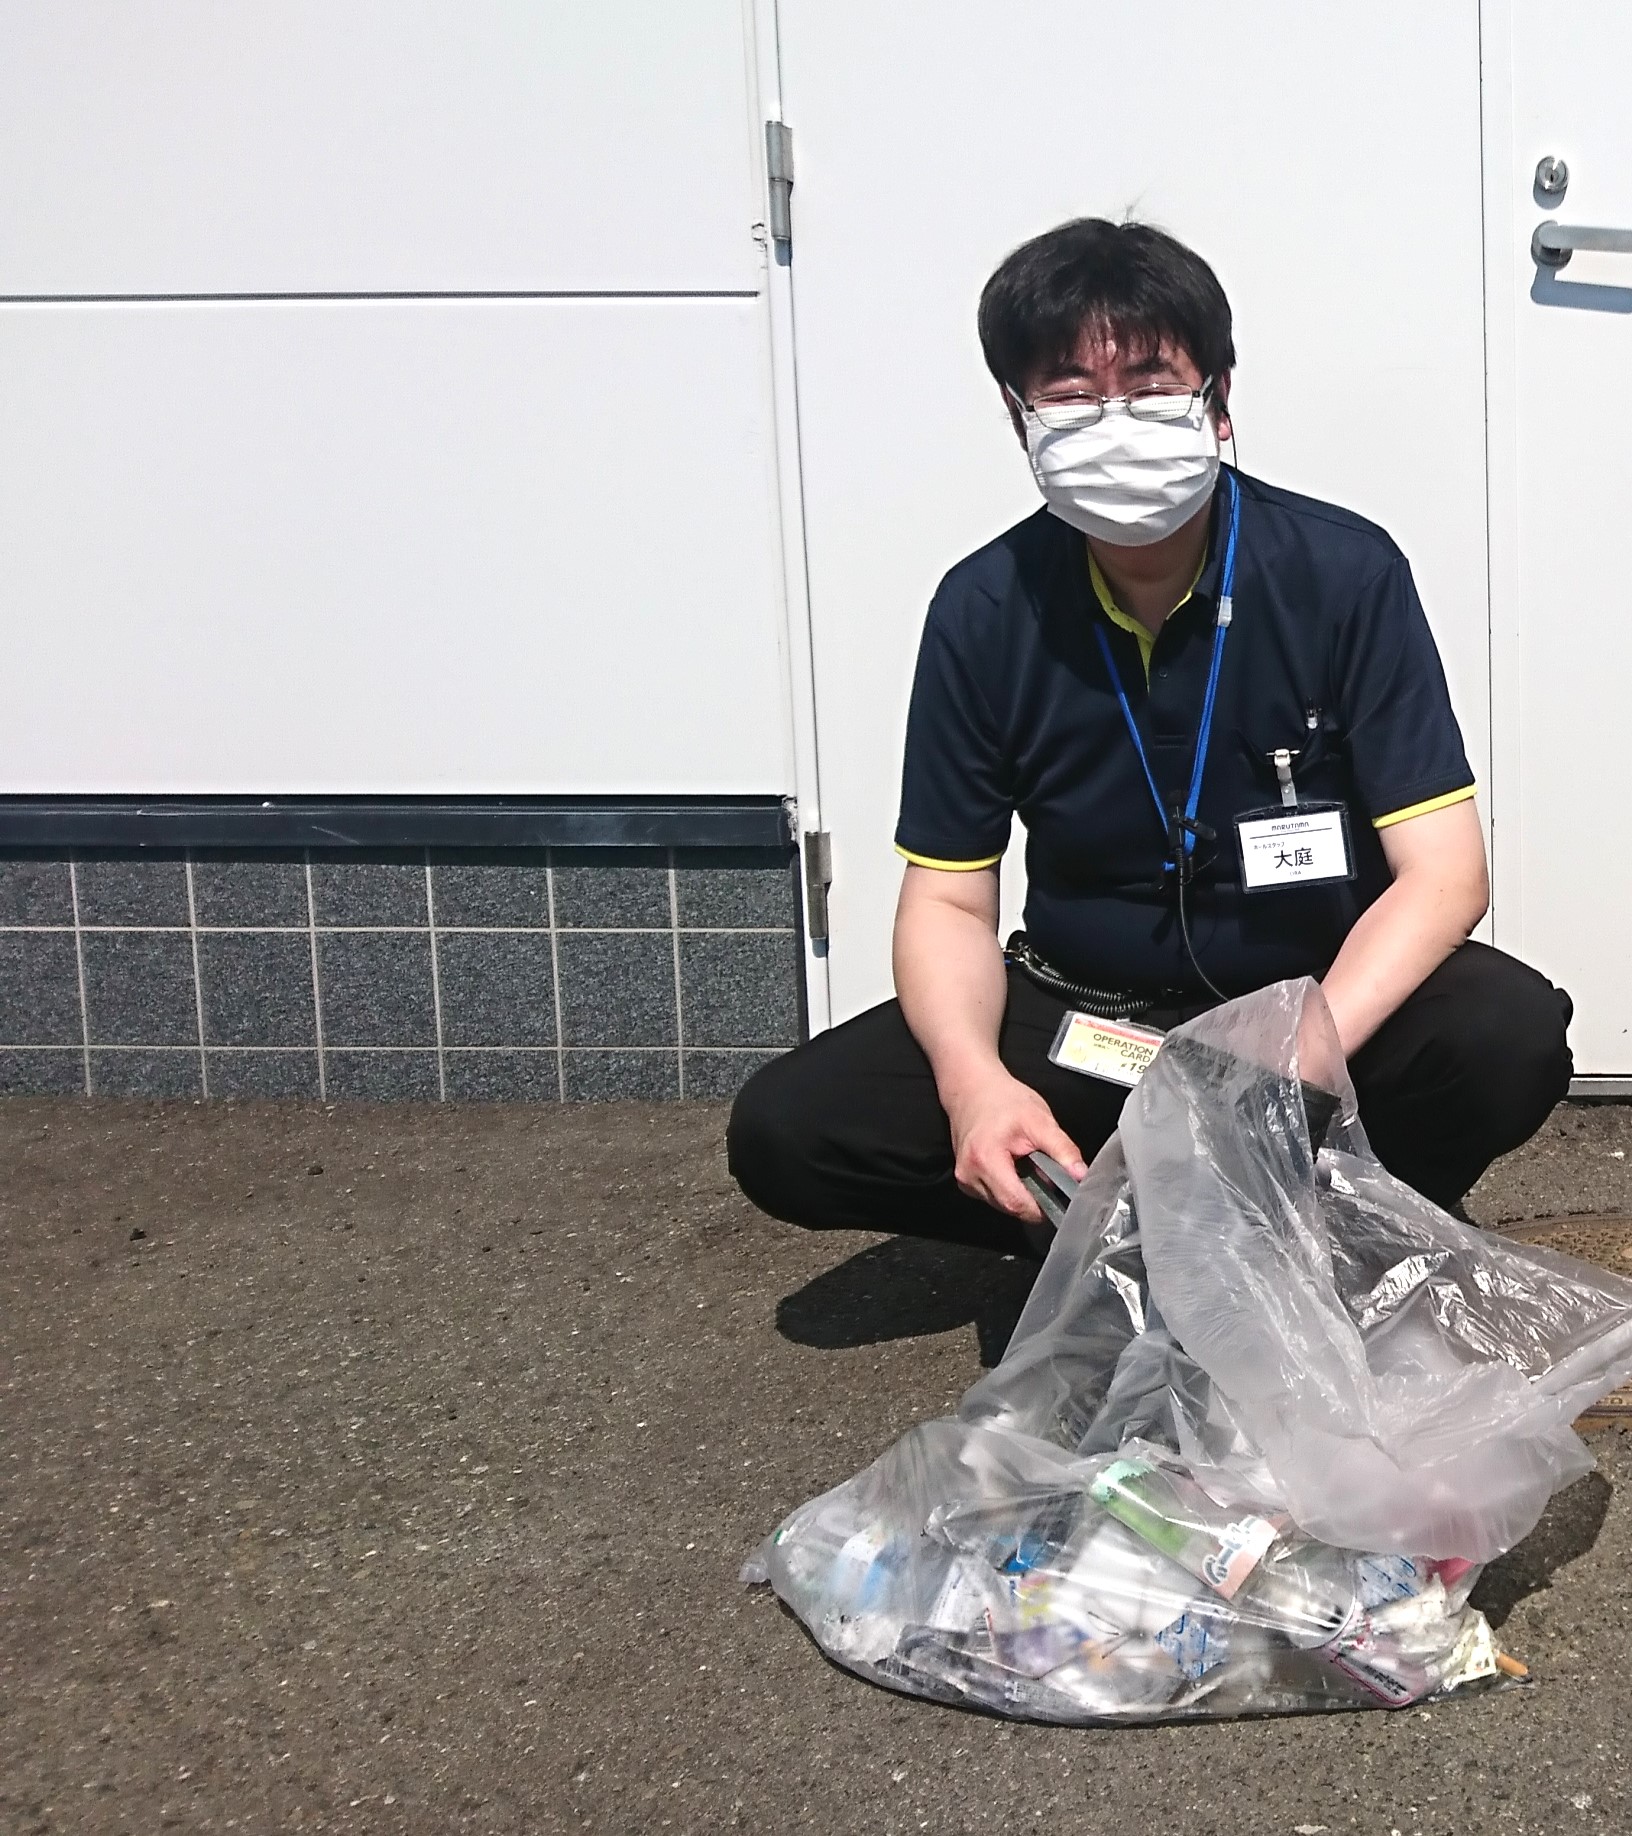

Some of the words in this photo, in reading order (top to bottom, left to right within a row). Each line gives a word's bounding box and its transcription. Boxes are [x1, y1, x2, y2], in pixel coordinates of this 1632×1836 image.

[1273, 846, 1314, 870] 大庭
[1093, 1032, 1154, 1056] OPERATION
[1120, 1049, 1151, 1063] CARD
